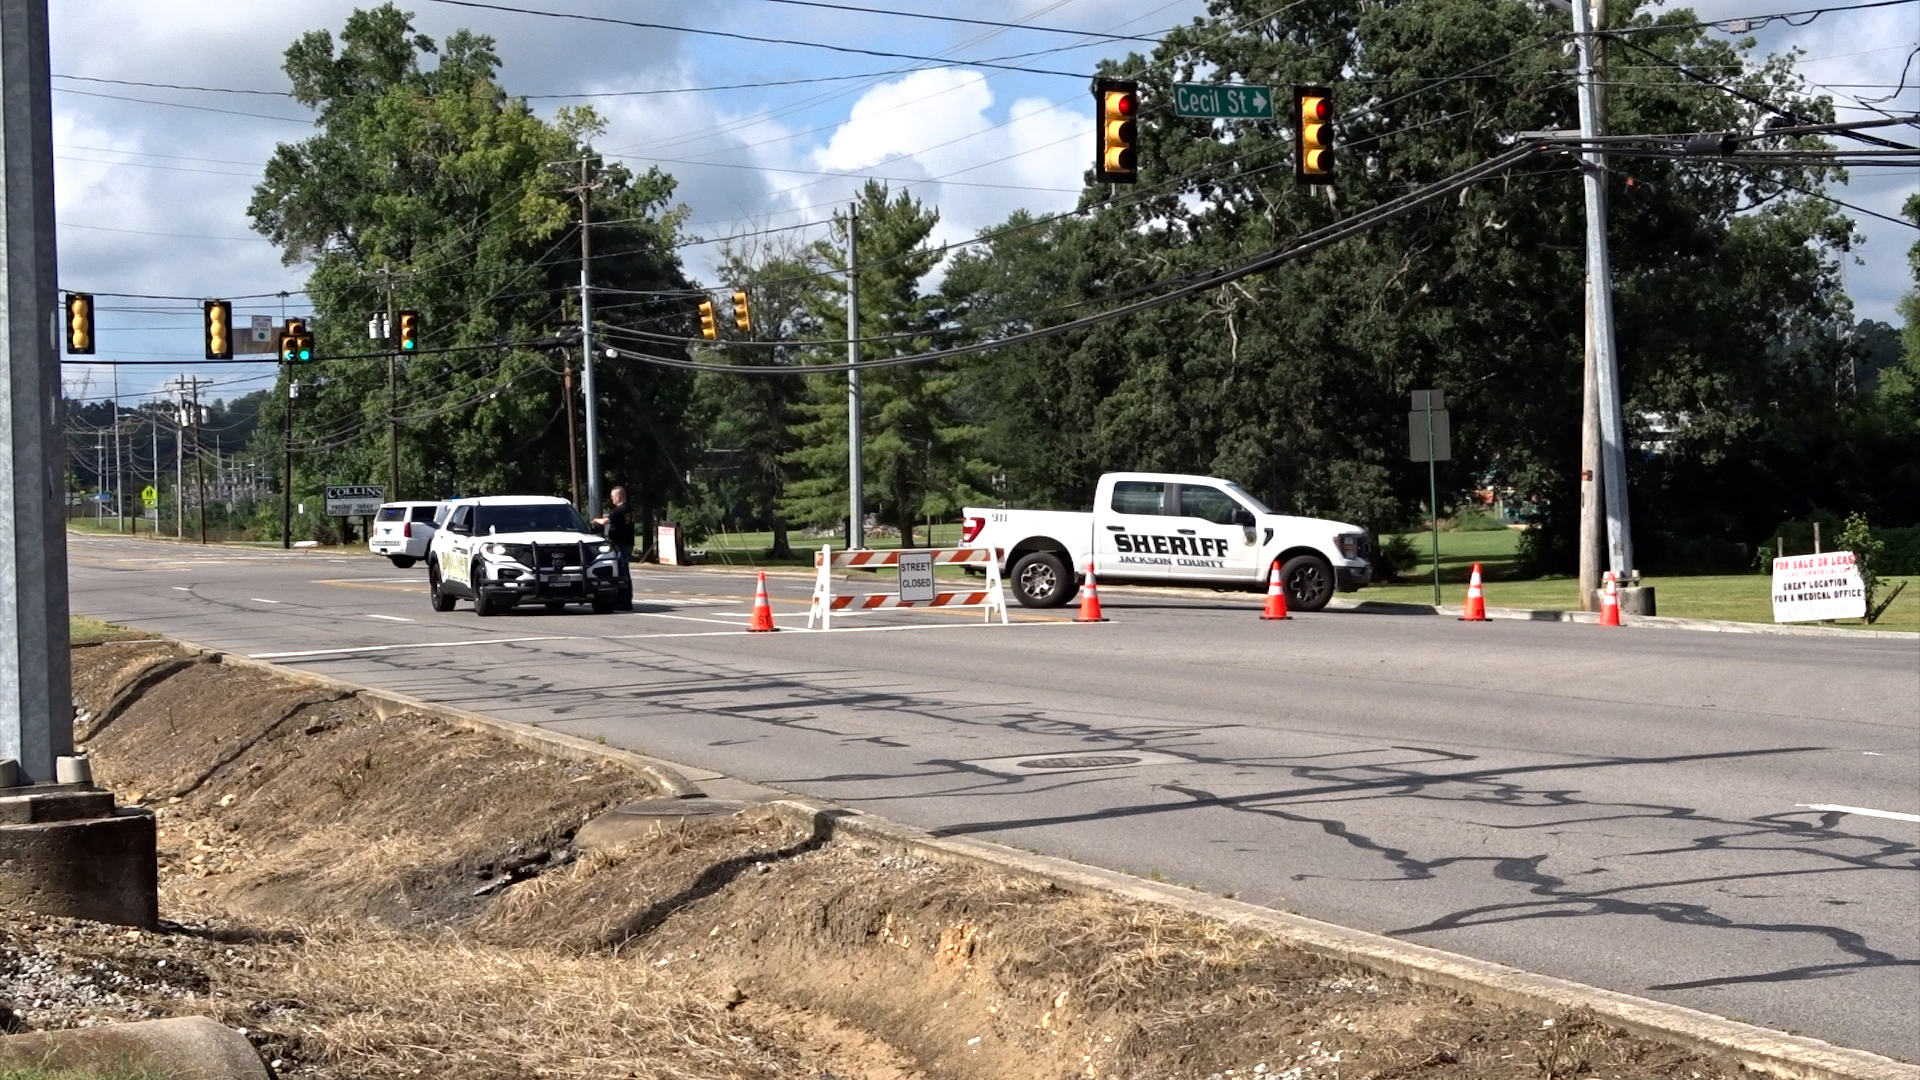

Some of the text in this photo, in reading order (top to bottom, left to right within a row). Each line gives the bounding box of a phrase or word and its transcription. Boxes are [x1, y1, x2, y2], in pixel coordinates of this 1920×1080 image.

[1178, 88, 1247, 113] Cecil St
[328, 487, 382, 499] COLLINS
[992, 513, 1007, 522] 911
[1114, 534, 1229, 557] SHERIFF
[901, 562, 930, 572] STREET
[1119, 556, 1225, 568] JACKSON COUNTY
[1775, 554, 1857, 570] FOR SALE OR LEAS
[903, 578, 931, 588] CLOSED
[1783, 578, 1848, 591] GREAT LOCATION
[1775, 589, 1862, 603] FOR A MEDICAL OFFICE
